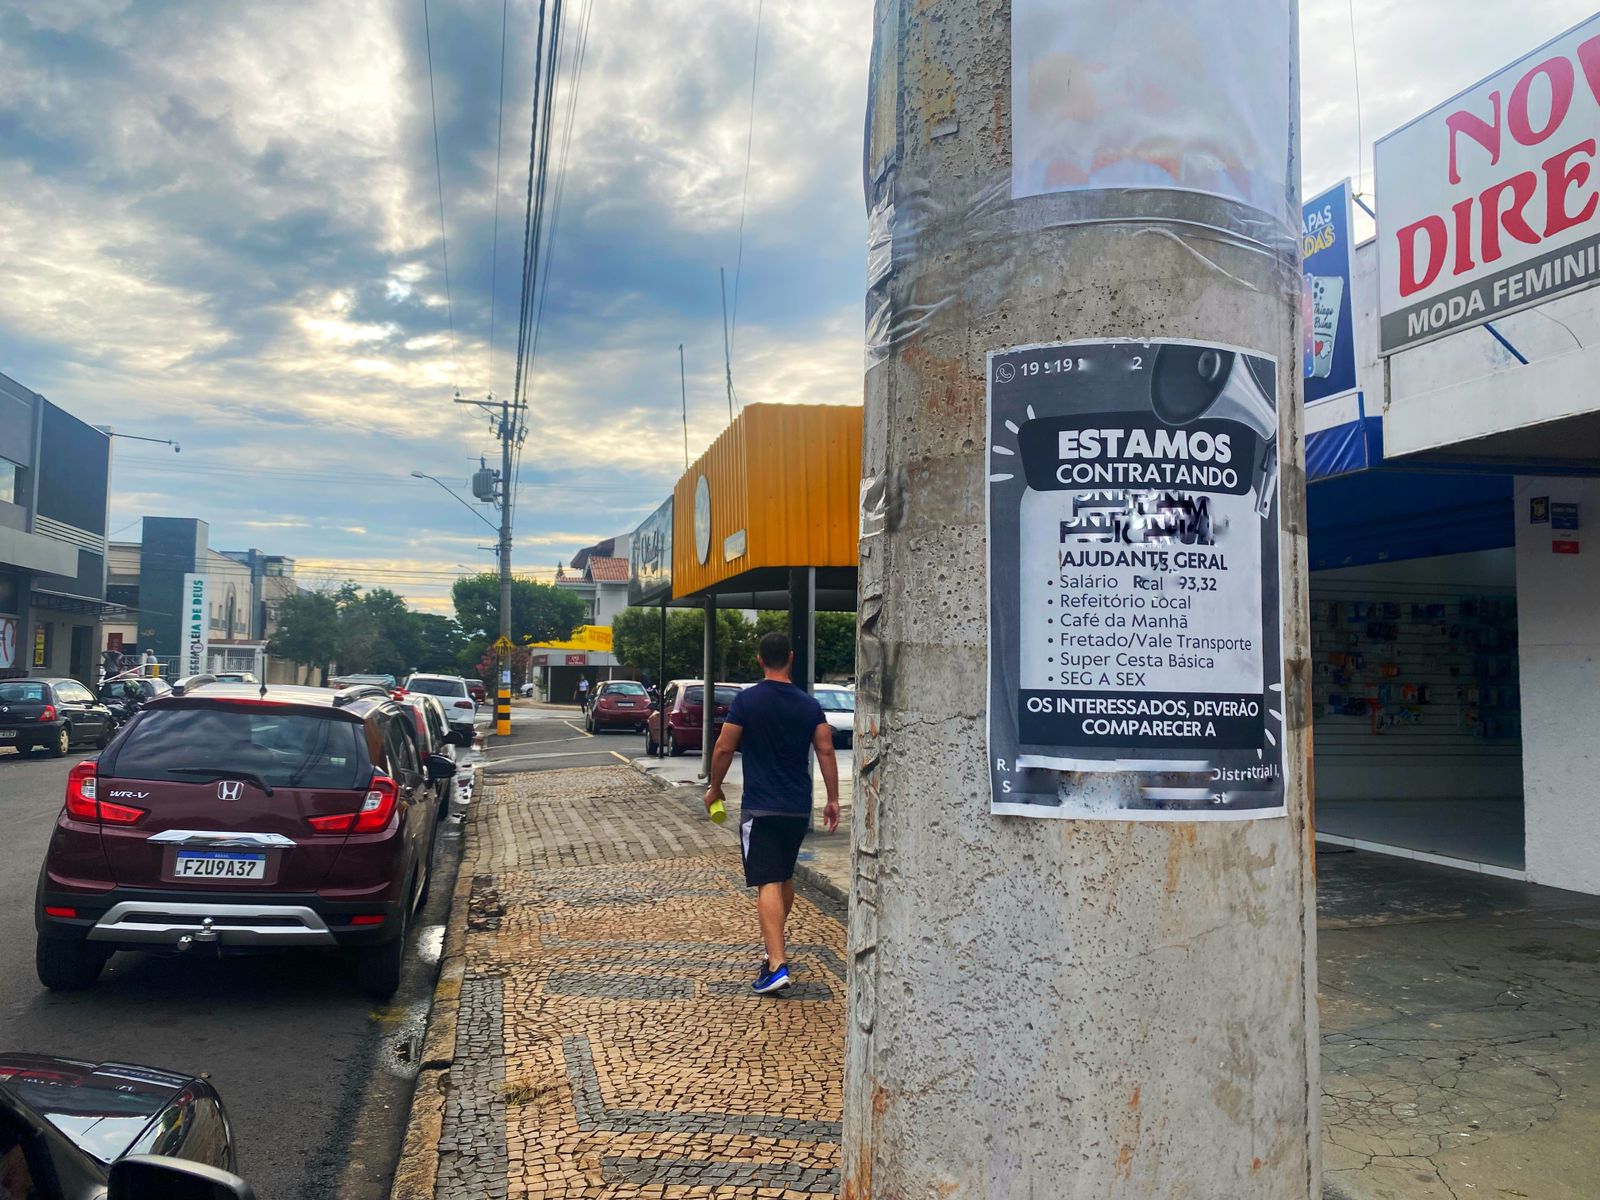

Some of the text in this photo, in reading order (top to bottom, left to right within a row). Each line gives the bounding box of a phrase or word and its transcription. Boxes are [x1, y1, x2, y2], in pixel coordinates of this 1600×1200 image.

[1396, 138, 1600, 298] DIRE
[1303, 223, 1337, 261] DAS
[1408, 243, 1600, 337] MODA FEMINI
[1020, 361, 1040, 376] 19
[1058, 429, 1232, 463] ESTAMOS
[1056, 463, 1238, 488] CONTRATANDO
[1062, 550, 1169, 568] AJUDANTE
[1174, 552, 1228, 571] GERAL
[1060, 575, 1118, 588] Salário
[193, 580, 204, 605] DEUS
[1060, 594, 1191, 610] Refeitório Local
[192, 608, 202, 620] DE
[1060, 612, 1188, 629] Café da Manhã
[1060, 632, 1252, 653] Fretado/Vale Transporte
[1060, 652, 1215, 669] Super Cesta Básica
[1060, 671, 1146, 687] SEG A SEX
[1027, 697, 1259, 719] OS INTERESSADOS, DEVERÃO
[1081, 719, 1217, 737] COMPARECER A
[996, 758, 1010, 772] R.
[109, 790, 149, 799] WR-V
[183, 859, 256, 877] FZU9A37
